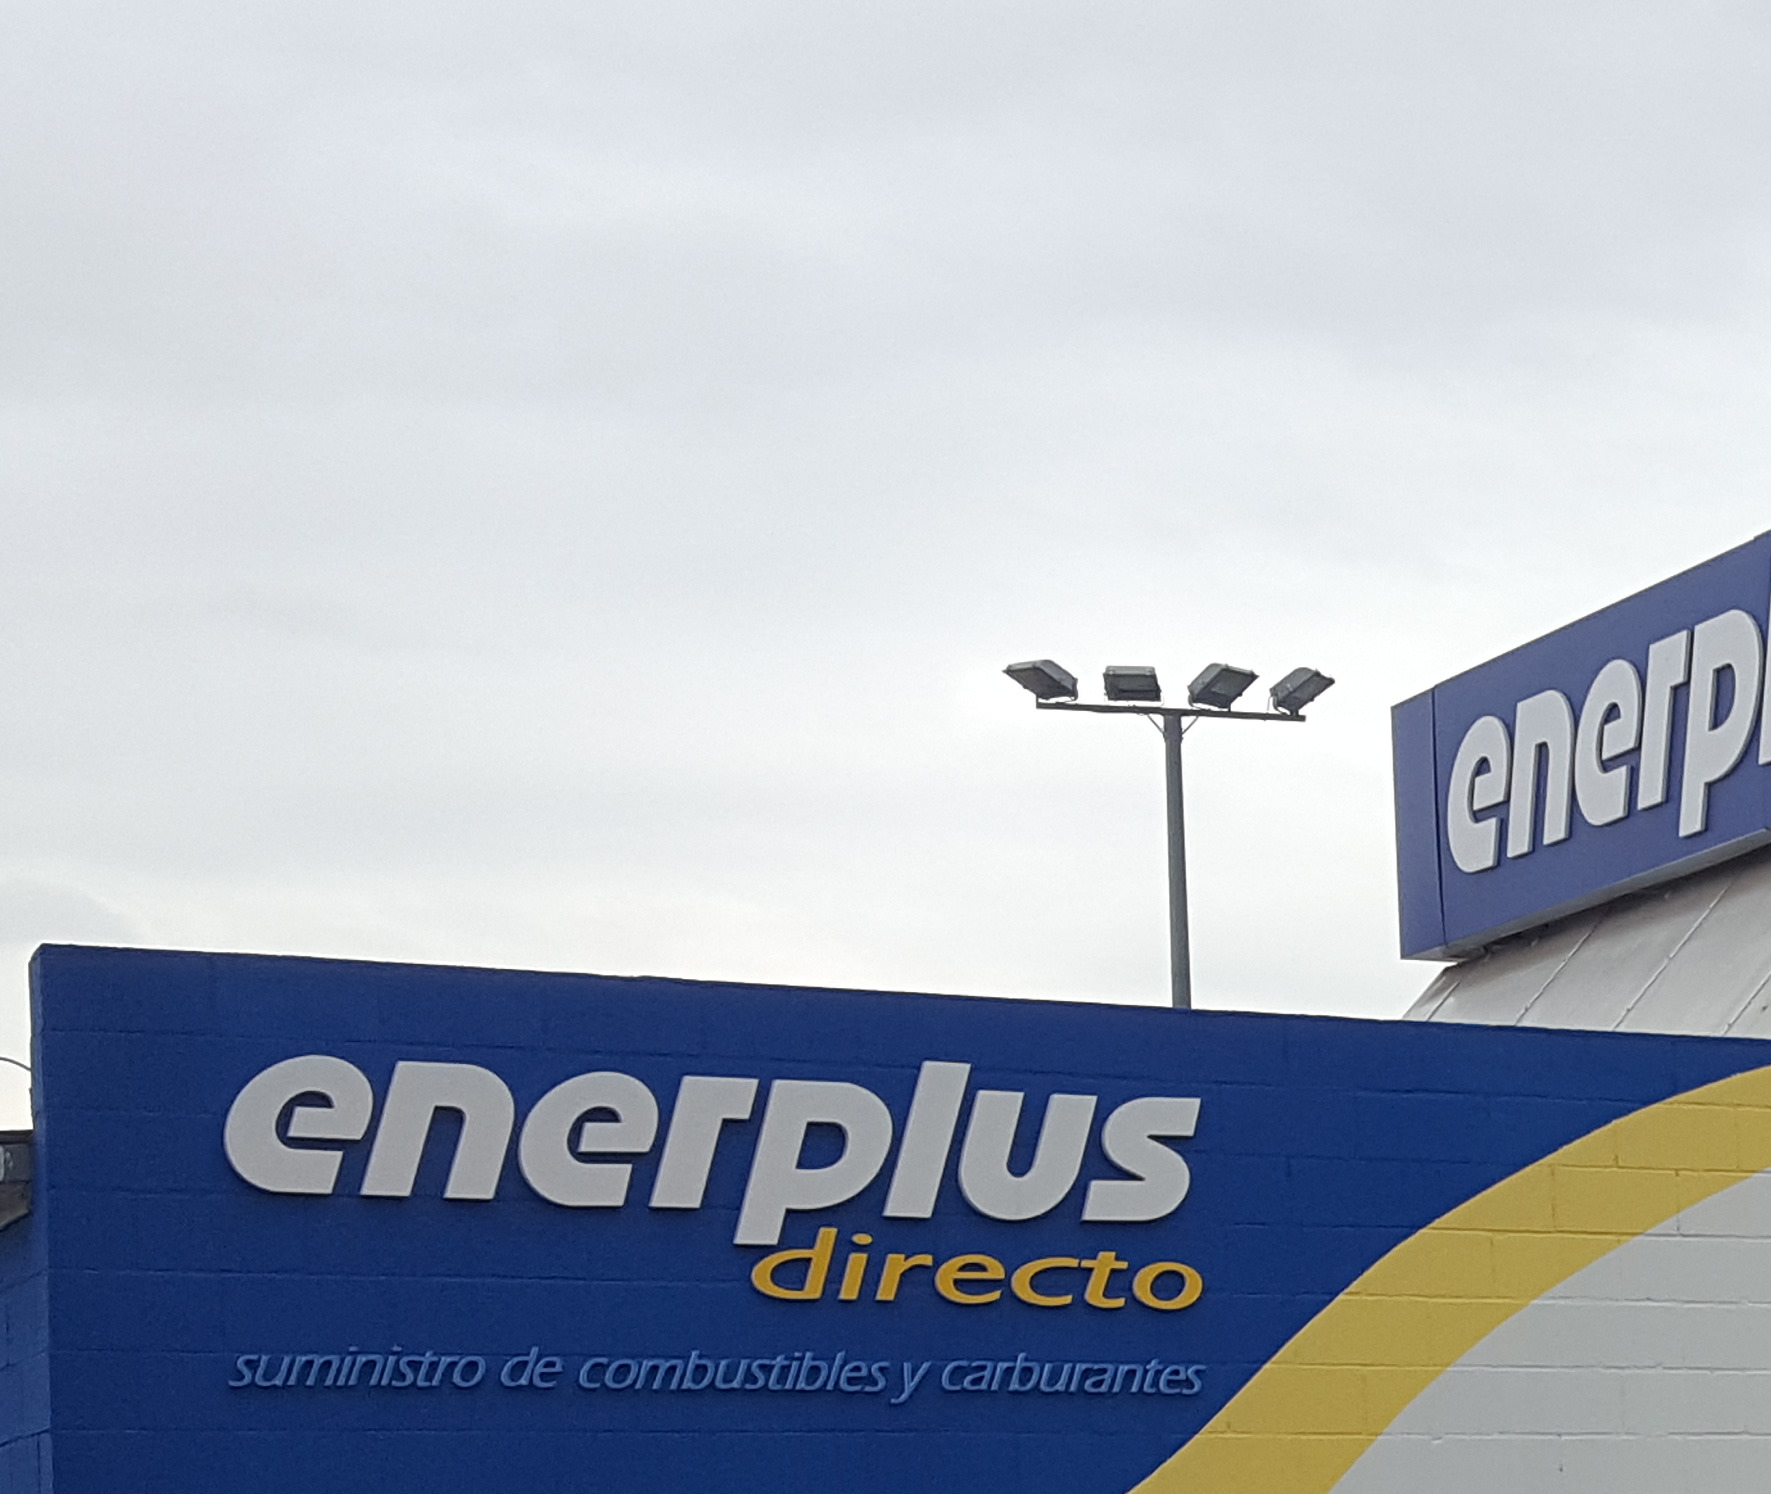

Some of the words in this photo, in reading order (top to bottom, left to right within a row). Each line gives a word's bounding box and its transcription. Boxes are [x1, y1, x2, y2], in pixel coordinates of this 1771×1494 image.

[223, 1054, 1202, 1246] enerplus
[750, 1226, 1204, 1310] directo
[228, 1346, 485, 1388] suministro
[500, 1346, 564, 1389] de
[578, 1348, 890, 1394] combustibles
[890, 1358, 930, 1405] y
[940, 1354, 1207, 1396] carburantes
